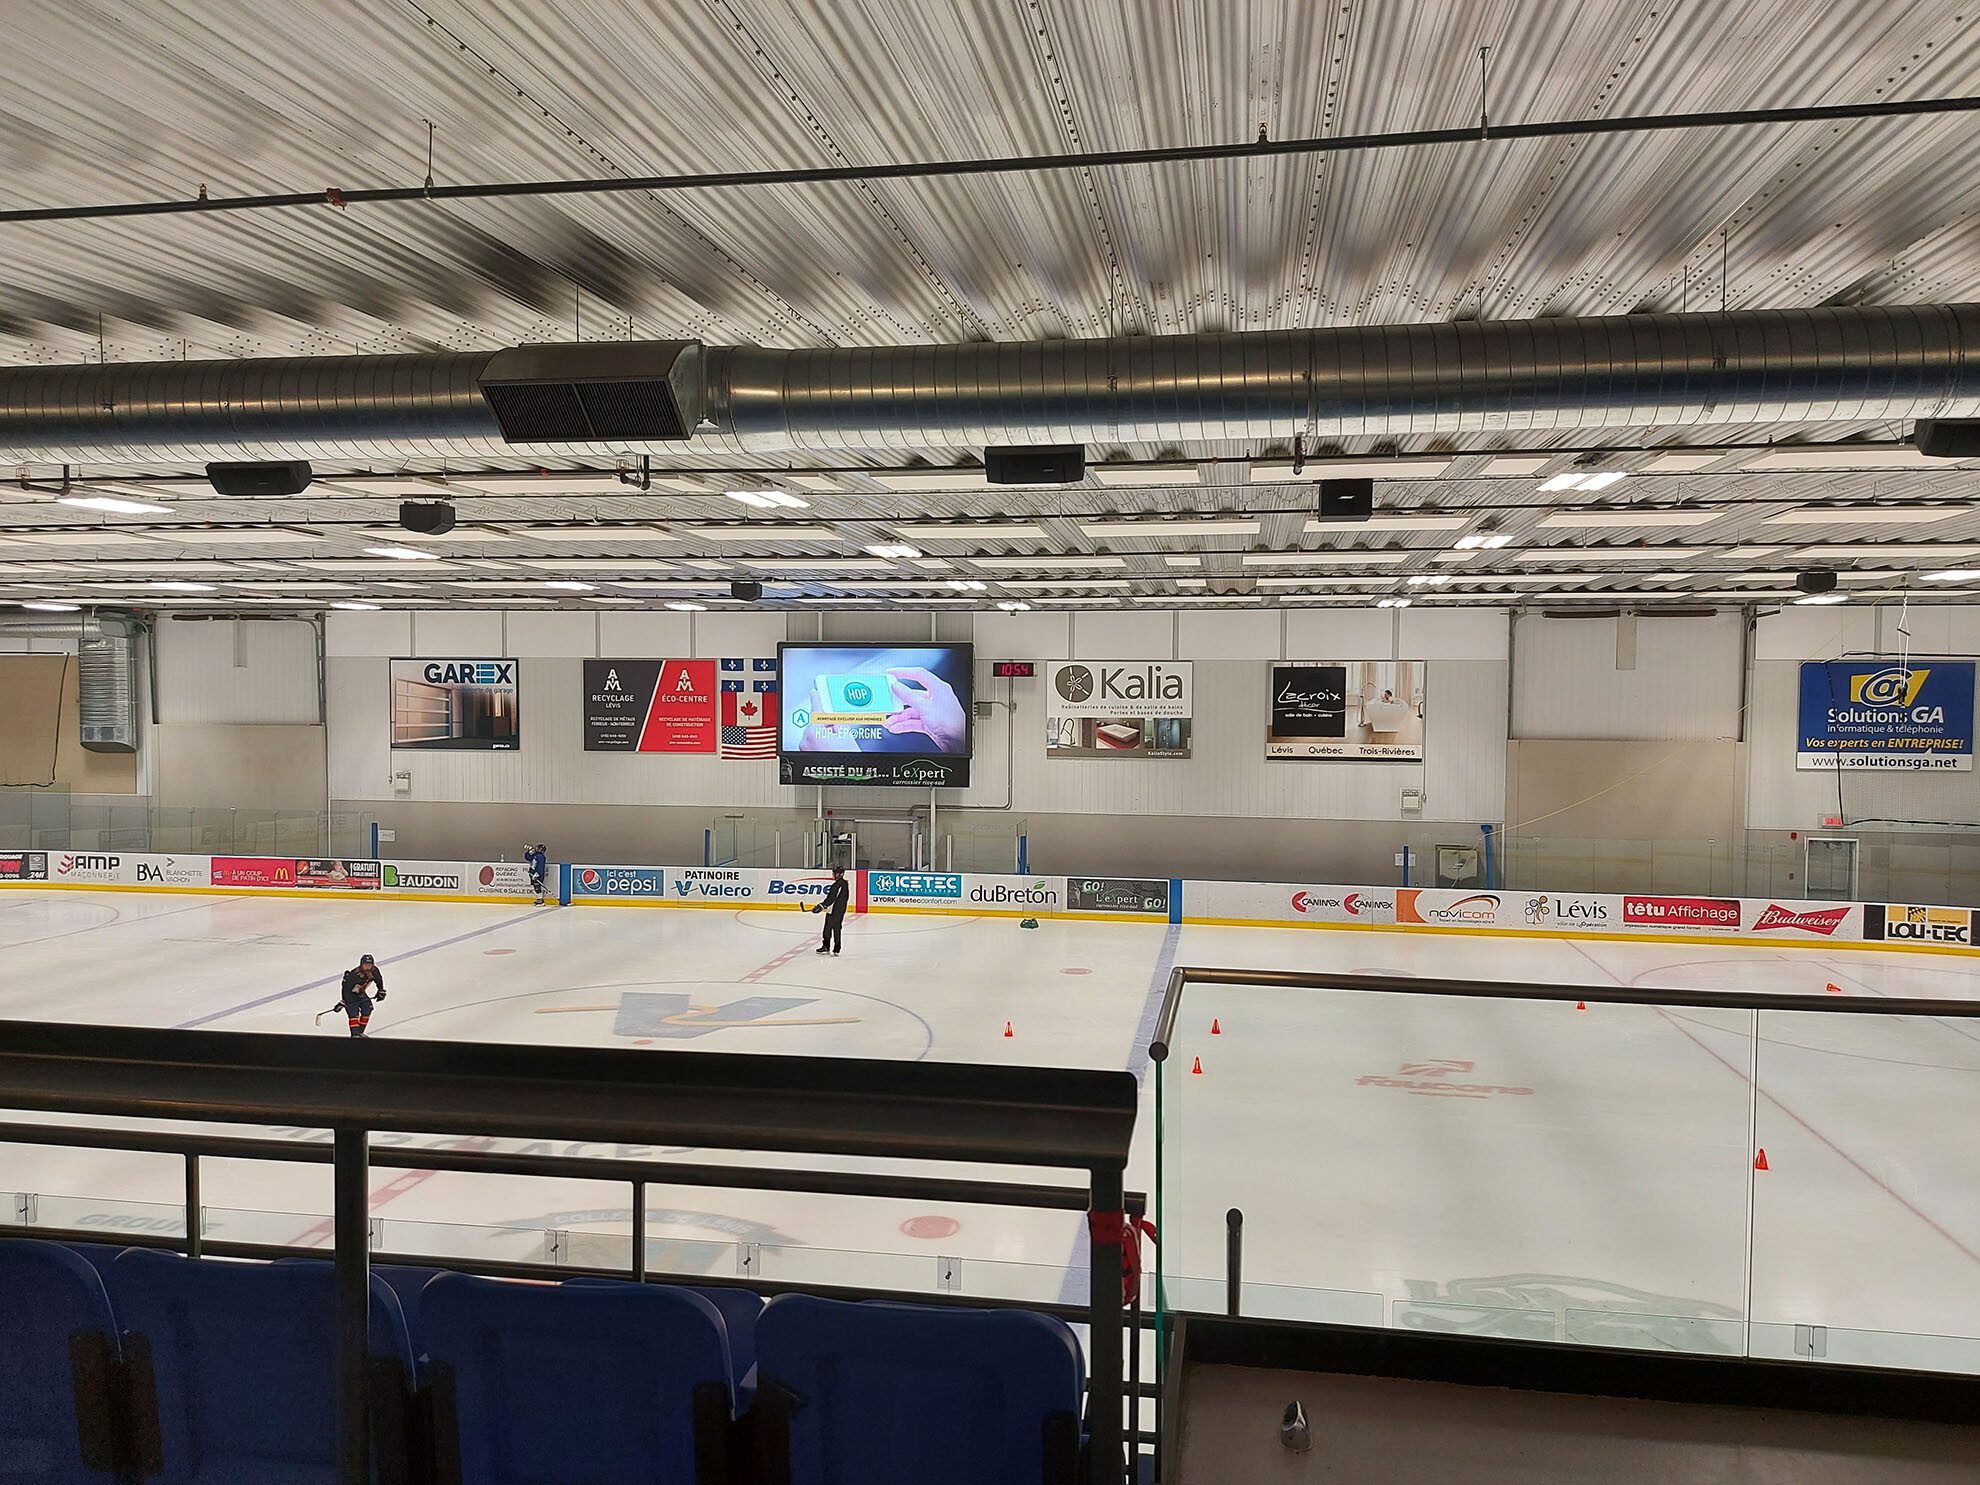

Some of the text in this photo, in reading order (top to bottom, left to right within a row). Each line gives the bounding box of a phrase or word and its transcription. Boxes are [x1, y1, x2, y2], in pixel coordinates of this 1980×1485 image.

[423, 663, 513, 684] GAREX
[1101, 665, 1183, 700] Kalia
[592, 694, 635, 702] RECYCLAGE
[661, 693, 708, 703] ÉCO-CENTRE
[848, 687, 868, 701] HOP
[1277, 681, 1342, 704] Lacroix
[1827, 705, 1945, 724] Solutions GA
[1886, 725, 1894, 733] &
[1805, 737, 1964, 750] Vos experts en ENTREPRISE!
[1271, 746, 1416, 757] Lévis Québec Trois-Rivières
[1811, 755, 1958, 770] www.solutionsga.net
[802, 765, 845, 777] ASSISTÉ
[847, 767, 864, 777] DU
[74, 855, 121, 870] AMP
[70, 870, 121, 881] MAÇONNERIE
[165, 869, 203, 877] BLANCHETTE
[383, 864, 459, 889] BEAUDOIN
[618, 869, 637, 878] c'est
[684, 870, 740, 881] PATINOIRE
[606, 876, 657, 895] pepsi
[767, 879, 832, 895] Besne
[895, 875, 958, 890] ICETEC
[1083, 880, 1104, 893] GO!
[507, 887, 527, 895] SALLE
[698, 883, 752, 898] Valero
[970, 885, 1057, 904] duBreton
[878, 896, 896, 904] YORK
[1144, 897, 1166, 909] GO!
[1302, 898, 1341, 908] CANIMEX
[1353, 899, 1394, 910] CANIMEX
[1429, 909, 1496, 919] novicom
[1555, 899, 1608, 920] Lévis
[1626, 901, 1739, 922] têtu Affichage
[1759, 909, 1842, 927] Budweiser
[1887, 922, 1969, 944] LOU-TEC
[75, 1214, 225, 1233] GROU
